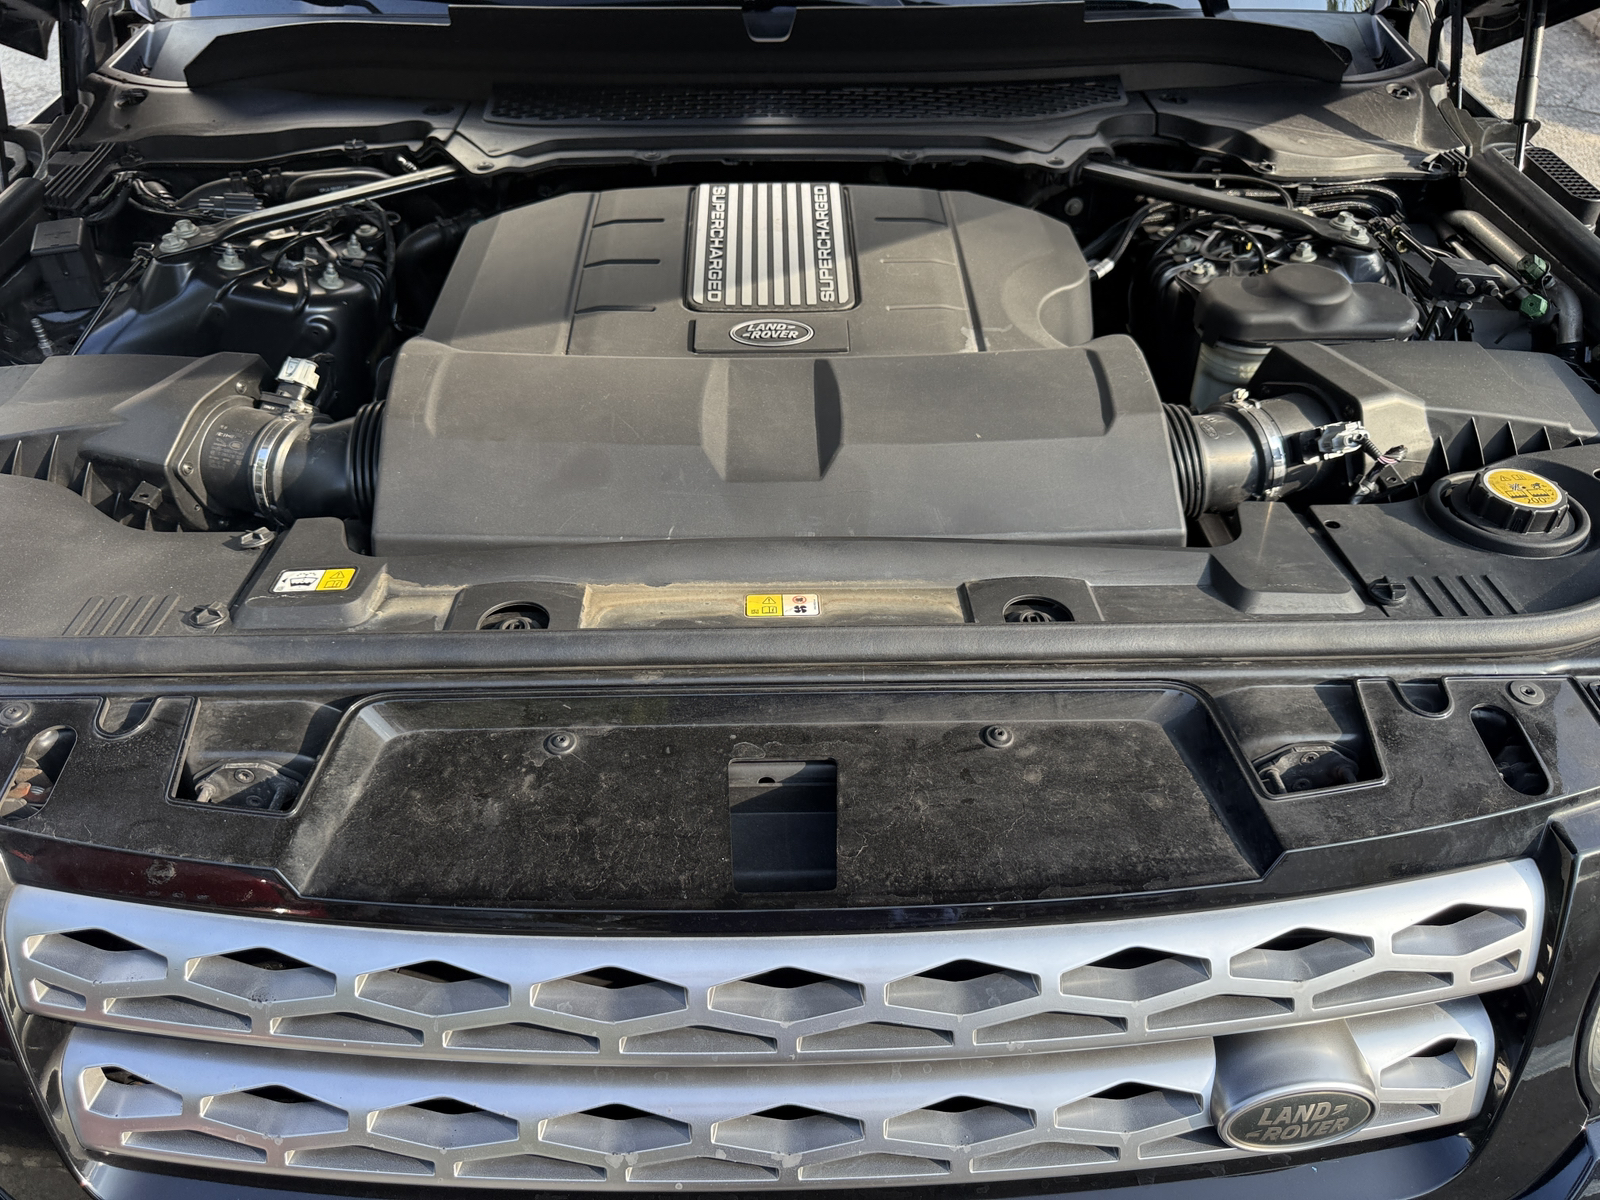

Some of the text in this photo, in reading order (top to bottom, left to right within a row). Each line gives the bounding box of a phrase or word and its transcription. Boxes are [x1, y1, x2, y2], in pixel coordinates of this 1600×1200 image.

[707, 185, 726, 302] SUPERCHARGED
[813, 185, 835, 302] SUPERCHARGED
[747, 323, 787, 331] LAND
[750, 330, 799, 339] ROVER
[1257, 1101, 1332, 1126] LAND
[1260, 1116, 1350, 1141] ROVER
